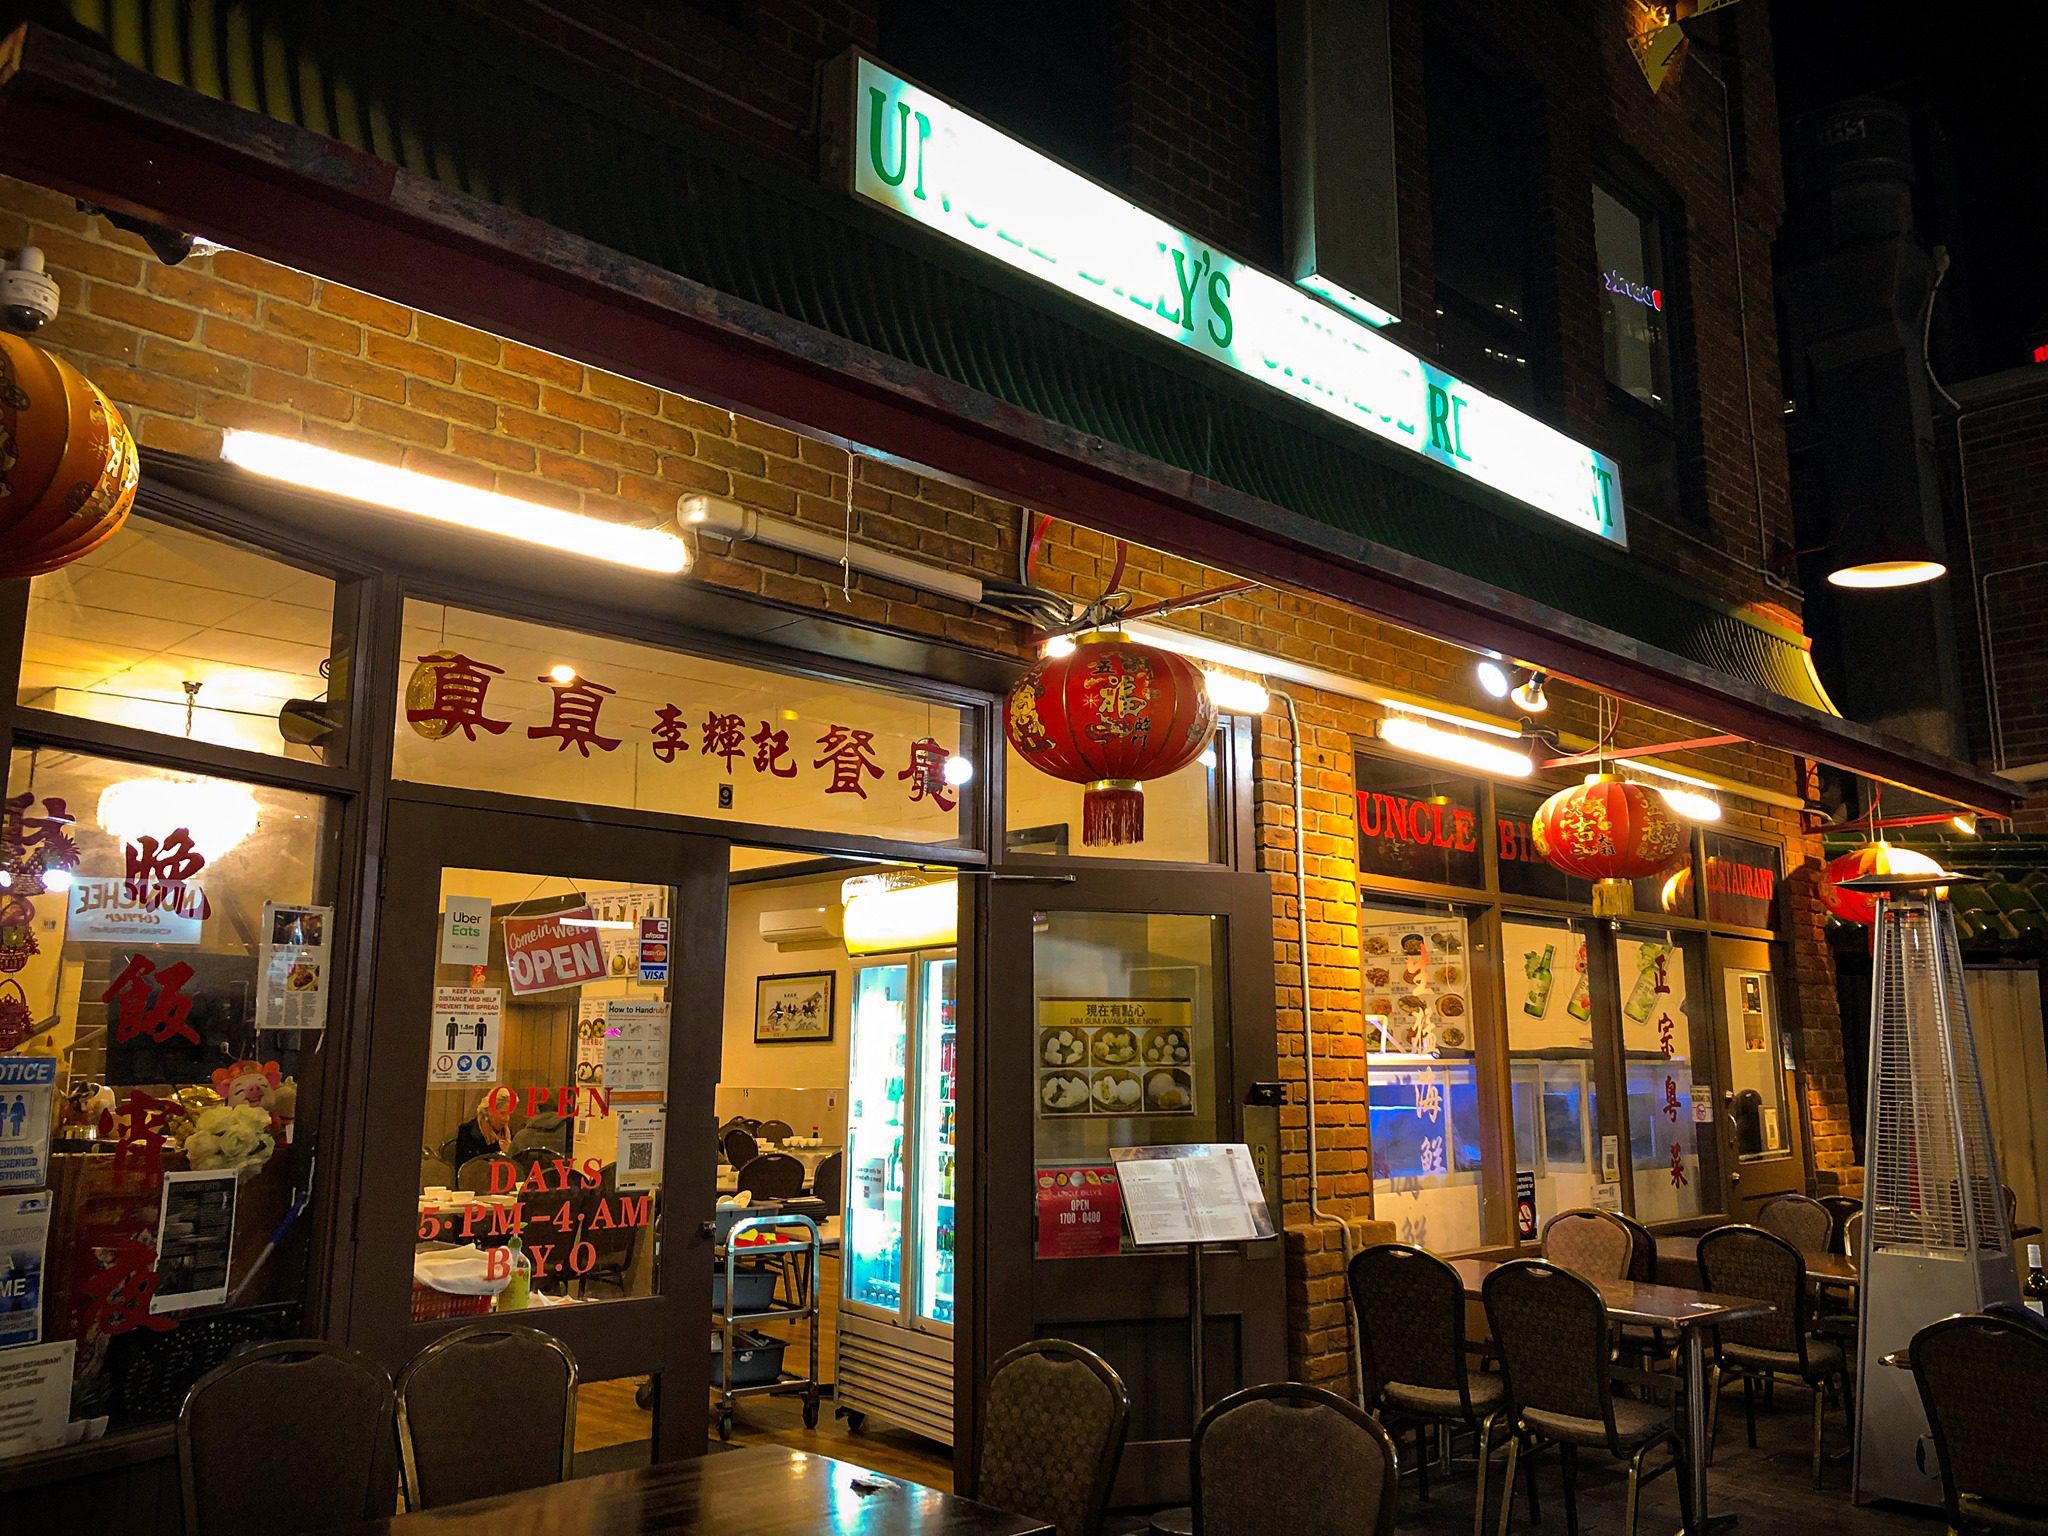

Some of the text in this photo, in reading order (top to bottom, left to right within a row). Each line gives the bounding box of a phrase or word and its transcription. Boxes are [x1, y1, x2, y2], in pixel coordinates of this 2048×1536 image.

[720, 786, 732, 806] 9
[1356, 789, 1476, 853] UNCLE
[453, 911, 482, 924] Uber
[451, 925, 481, 937] Eats
[509, 921, 590, 951] Come in Were
[513, 940, 600, 986] OPEN
[644, 970, 665, 980] VISA
[608, 1006, 626, 1014] How
[626, 1006, 633, 1014] to
[1086, 1004, 1146, 1017] 現在有點心
[1102, 1018, 1141, 1026] AVAILABLE
[488, 1086, 613, 1118] OPEN
[488, 1158, 604, 1194] DAYS
[1071, 1200, 1089, 1211] OPEN
[1060, 1212, 1076, 1224] 1700
[1082, 1212, 1101, 1224] 0400
